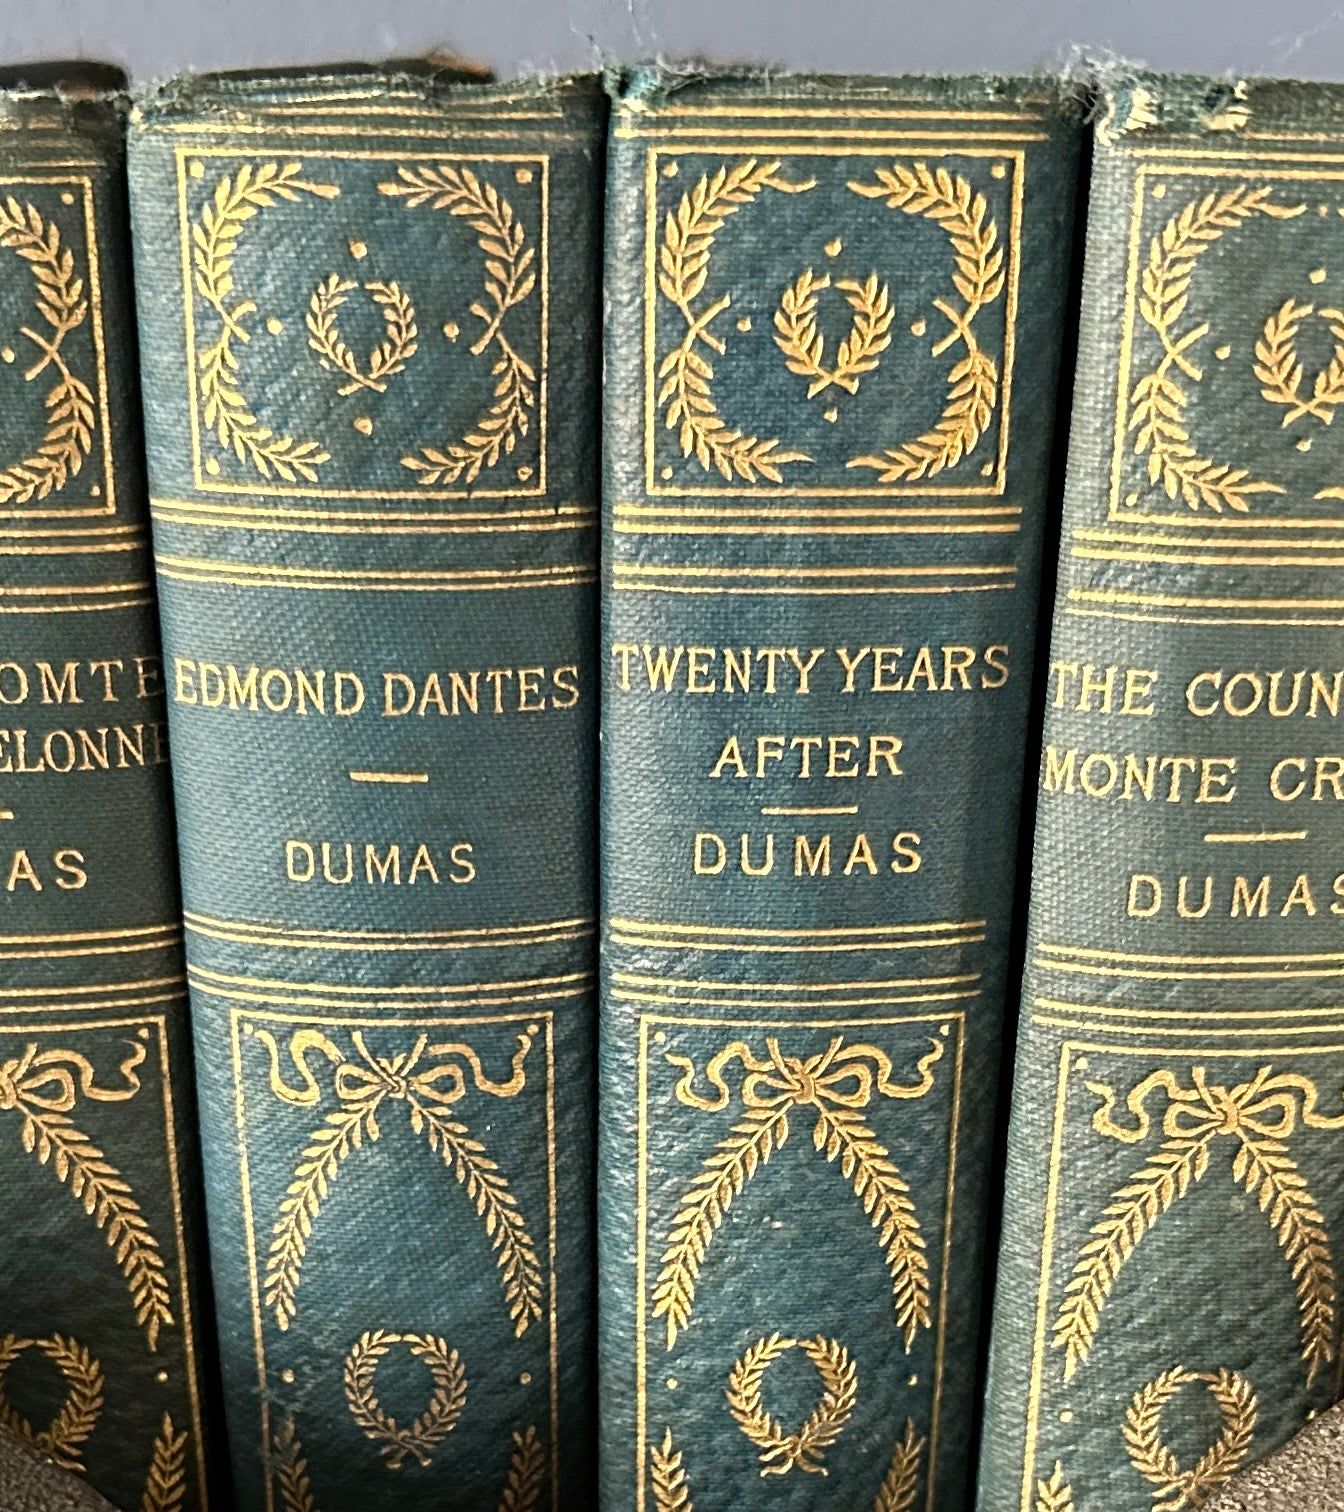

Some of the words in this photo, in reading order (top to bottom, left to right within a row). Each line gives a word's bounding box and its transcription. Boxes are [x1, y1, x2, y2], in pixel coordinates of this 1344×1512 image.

[173, 657, 366, 717] EDMOND
[383, 665, 581, 717] DANTES
[611, 644, 826, 695] TWENTY
[839, 644, 1010, 692] YEARS
[1049, 661, 1159, 716] THE
[709, 735, 903, 778] AFTER
[1042, 745, 1237, 804] MONTE
[285, 838, 477, 885] DUMAS
[693, 830, 923, 877] DUMAS
